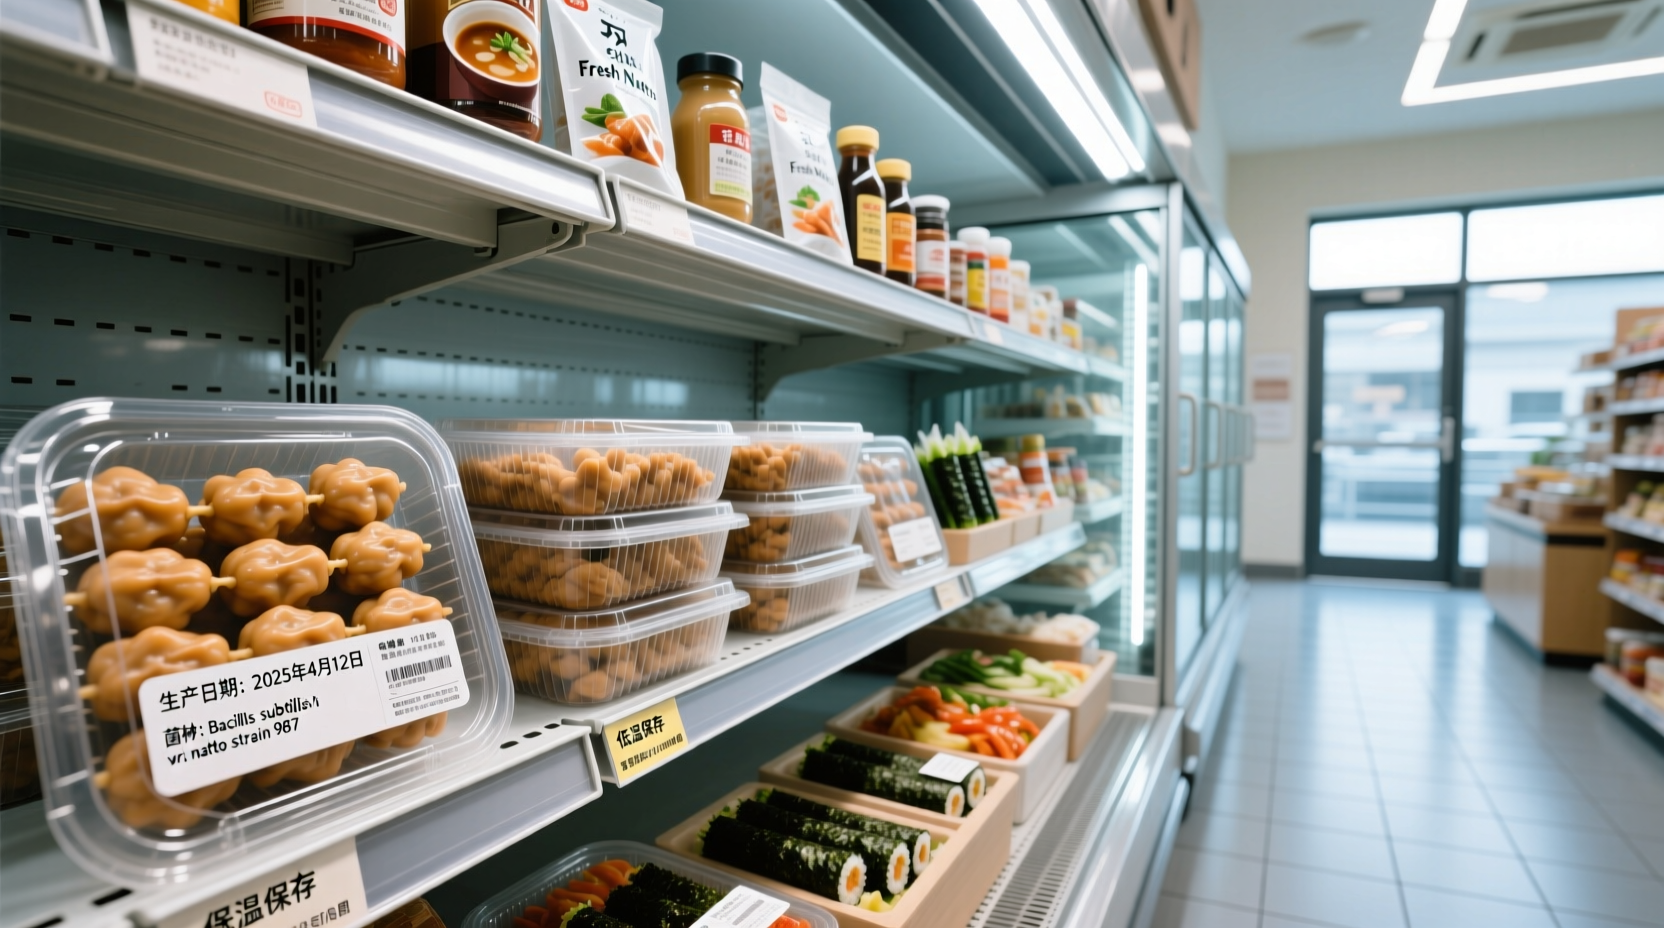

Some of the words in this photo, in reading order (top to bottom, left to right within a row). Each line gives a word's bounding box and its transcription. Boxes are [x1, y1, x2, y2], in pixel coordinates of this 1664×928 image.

[578, 60, 620, 81] Fresh
[251, 650, 364, 691] 2025年4月12日
[231, 727, 271, 749] strain
[273, 717, 299, 736] 987
[616, 715, 666, 750] 低温保存
[203, 870, 316, 928] 保温保存
